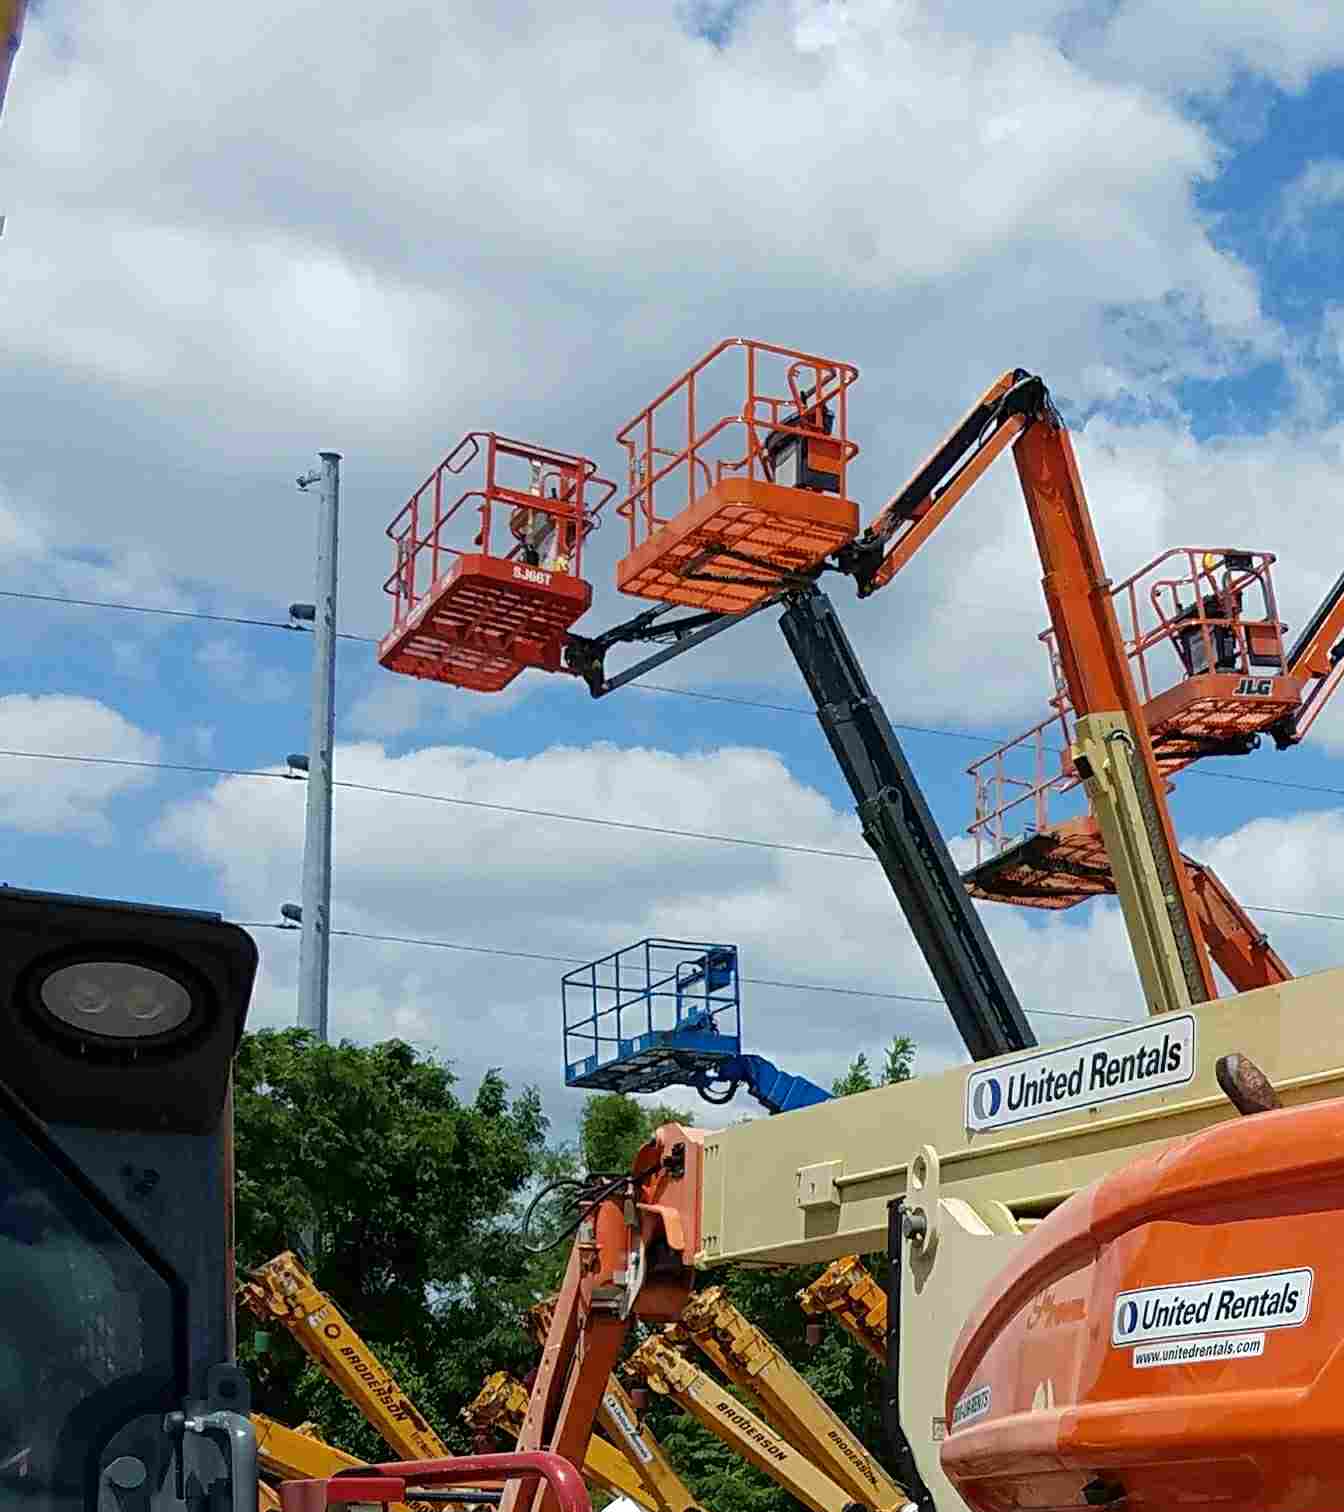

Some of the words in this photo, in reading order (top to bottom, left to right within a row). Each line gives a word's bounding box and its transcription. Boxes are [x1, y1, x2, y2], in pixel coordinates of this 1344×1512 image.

[1232, 678, 1273, 697] JLG
[1007, 1058, 1085, 1110] United
[1089, 1035, 1182, 1091] Rentals
[1142, 1292, 1213, 1330] United
[1215, 1282, 1299, 1321] Rentals
[1135, 1339, 1261, 1365] www.unitedrentals.com
[340, 1346, 410, 1422] BRODERSON
[716, 1401, 788, 1462] BRODERSON
[827, 1430, 878, 1486] BRODERSON
